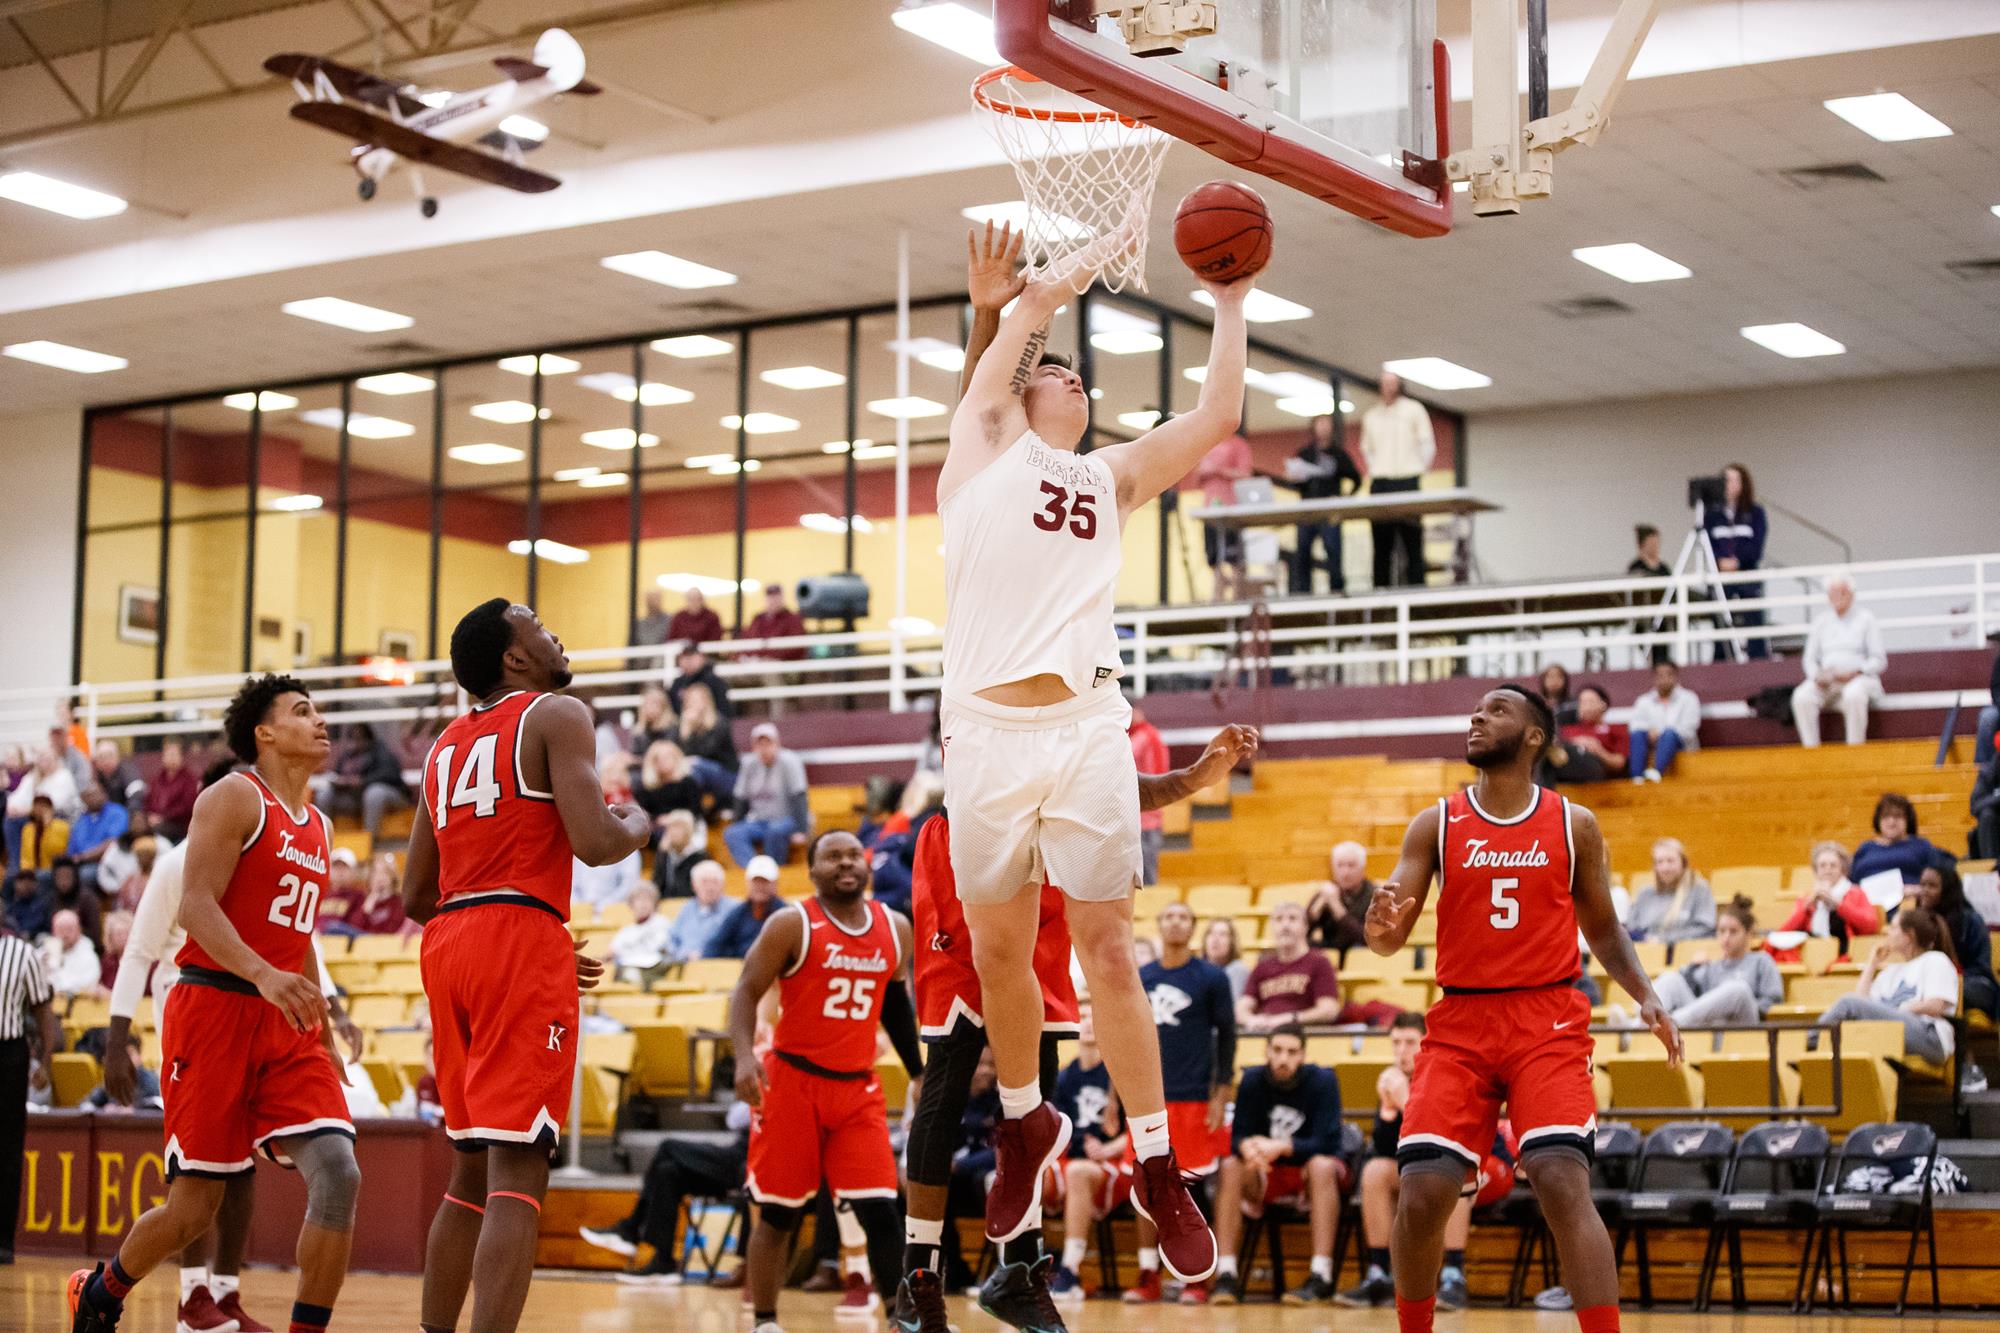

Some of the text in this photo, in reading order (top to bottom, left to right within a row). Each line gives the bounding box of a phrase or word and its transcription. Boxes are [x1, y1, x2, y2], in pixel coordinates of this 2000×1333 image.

[1033, 479, 1097, 540] 35
[435, 731, 501, 830] 14
[276, 829, 327, 874] Tornado
[1462, 838, 1550, 868] Tornado
[267, 872, 320, 934] 20
[1489, 877, 1520, 930] 5
[821, 942, 888, 972] Tornado
[823, 976, 877, 1020] 25
